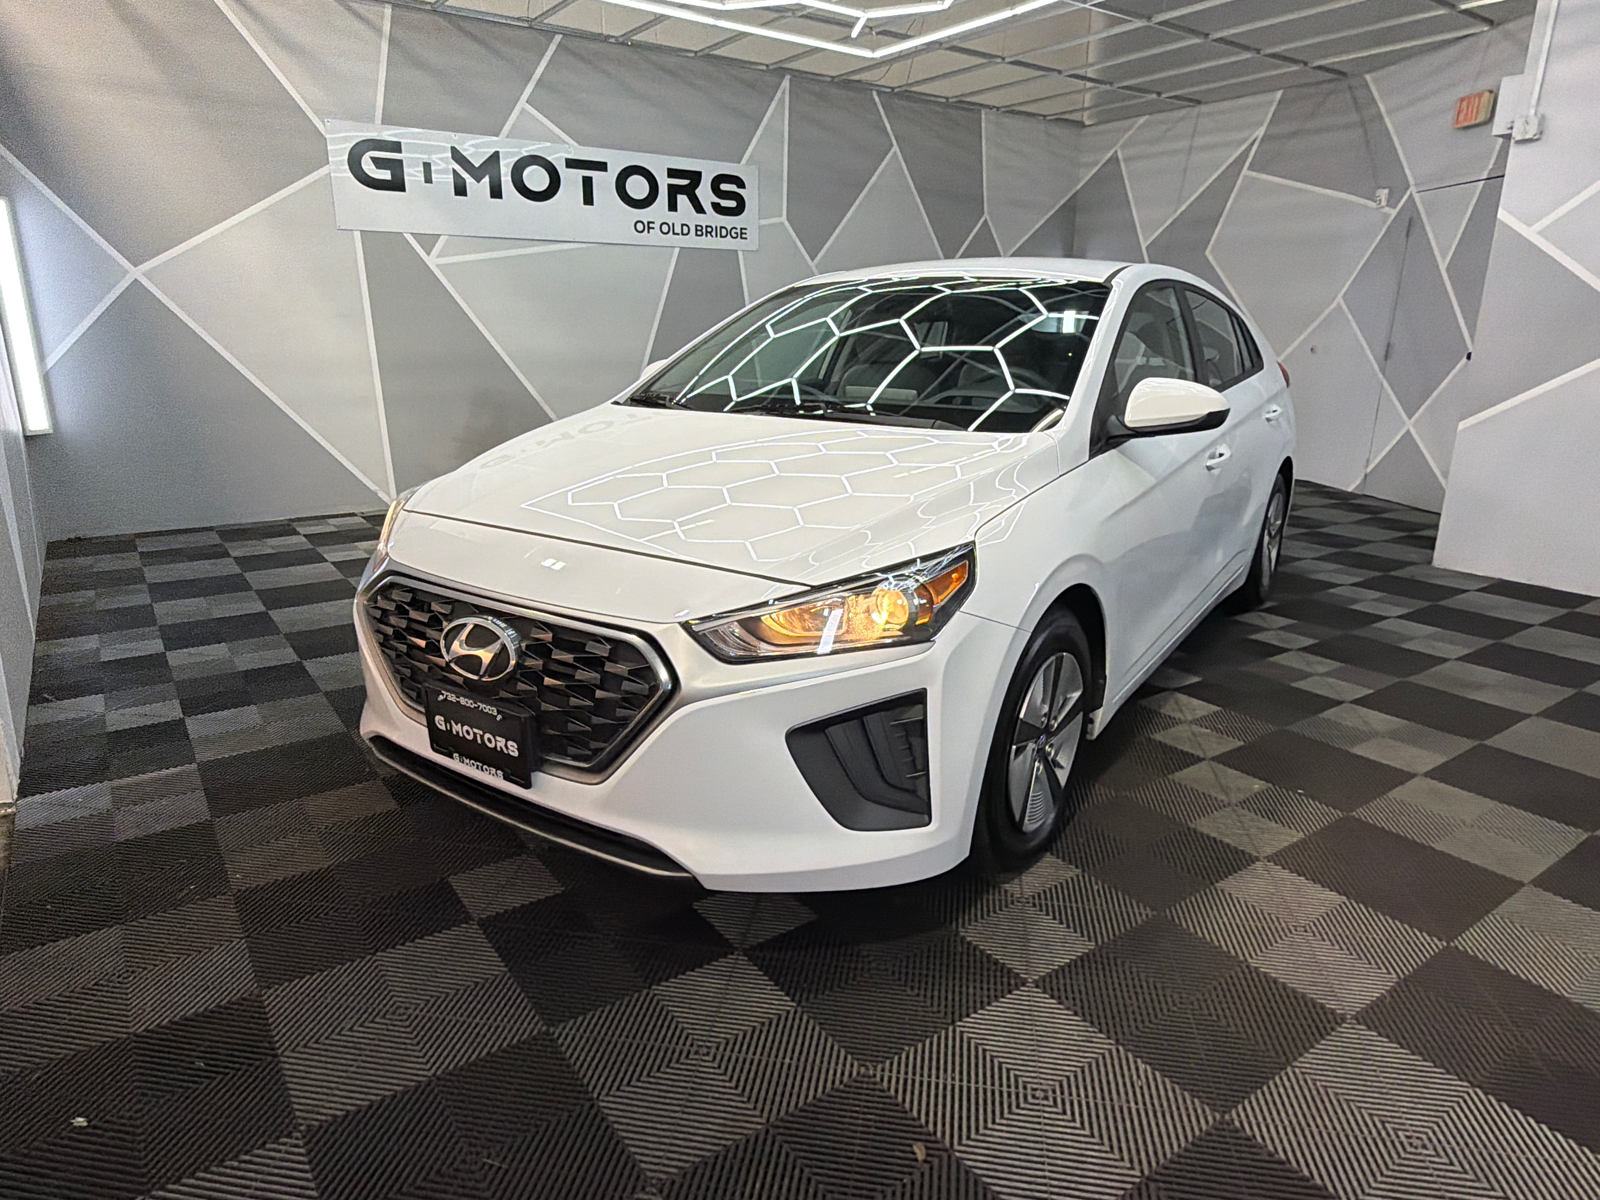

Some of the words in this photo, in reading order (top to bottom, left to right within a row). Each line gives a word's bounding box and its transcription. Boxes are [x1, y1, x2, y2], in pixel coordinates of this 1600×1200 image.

[634, 220, 655, 234] OF
[660, 221, 691, 236] OLD
[695, 224, 748, 240] BRIDGE
